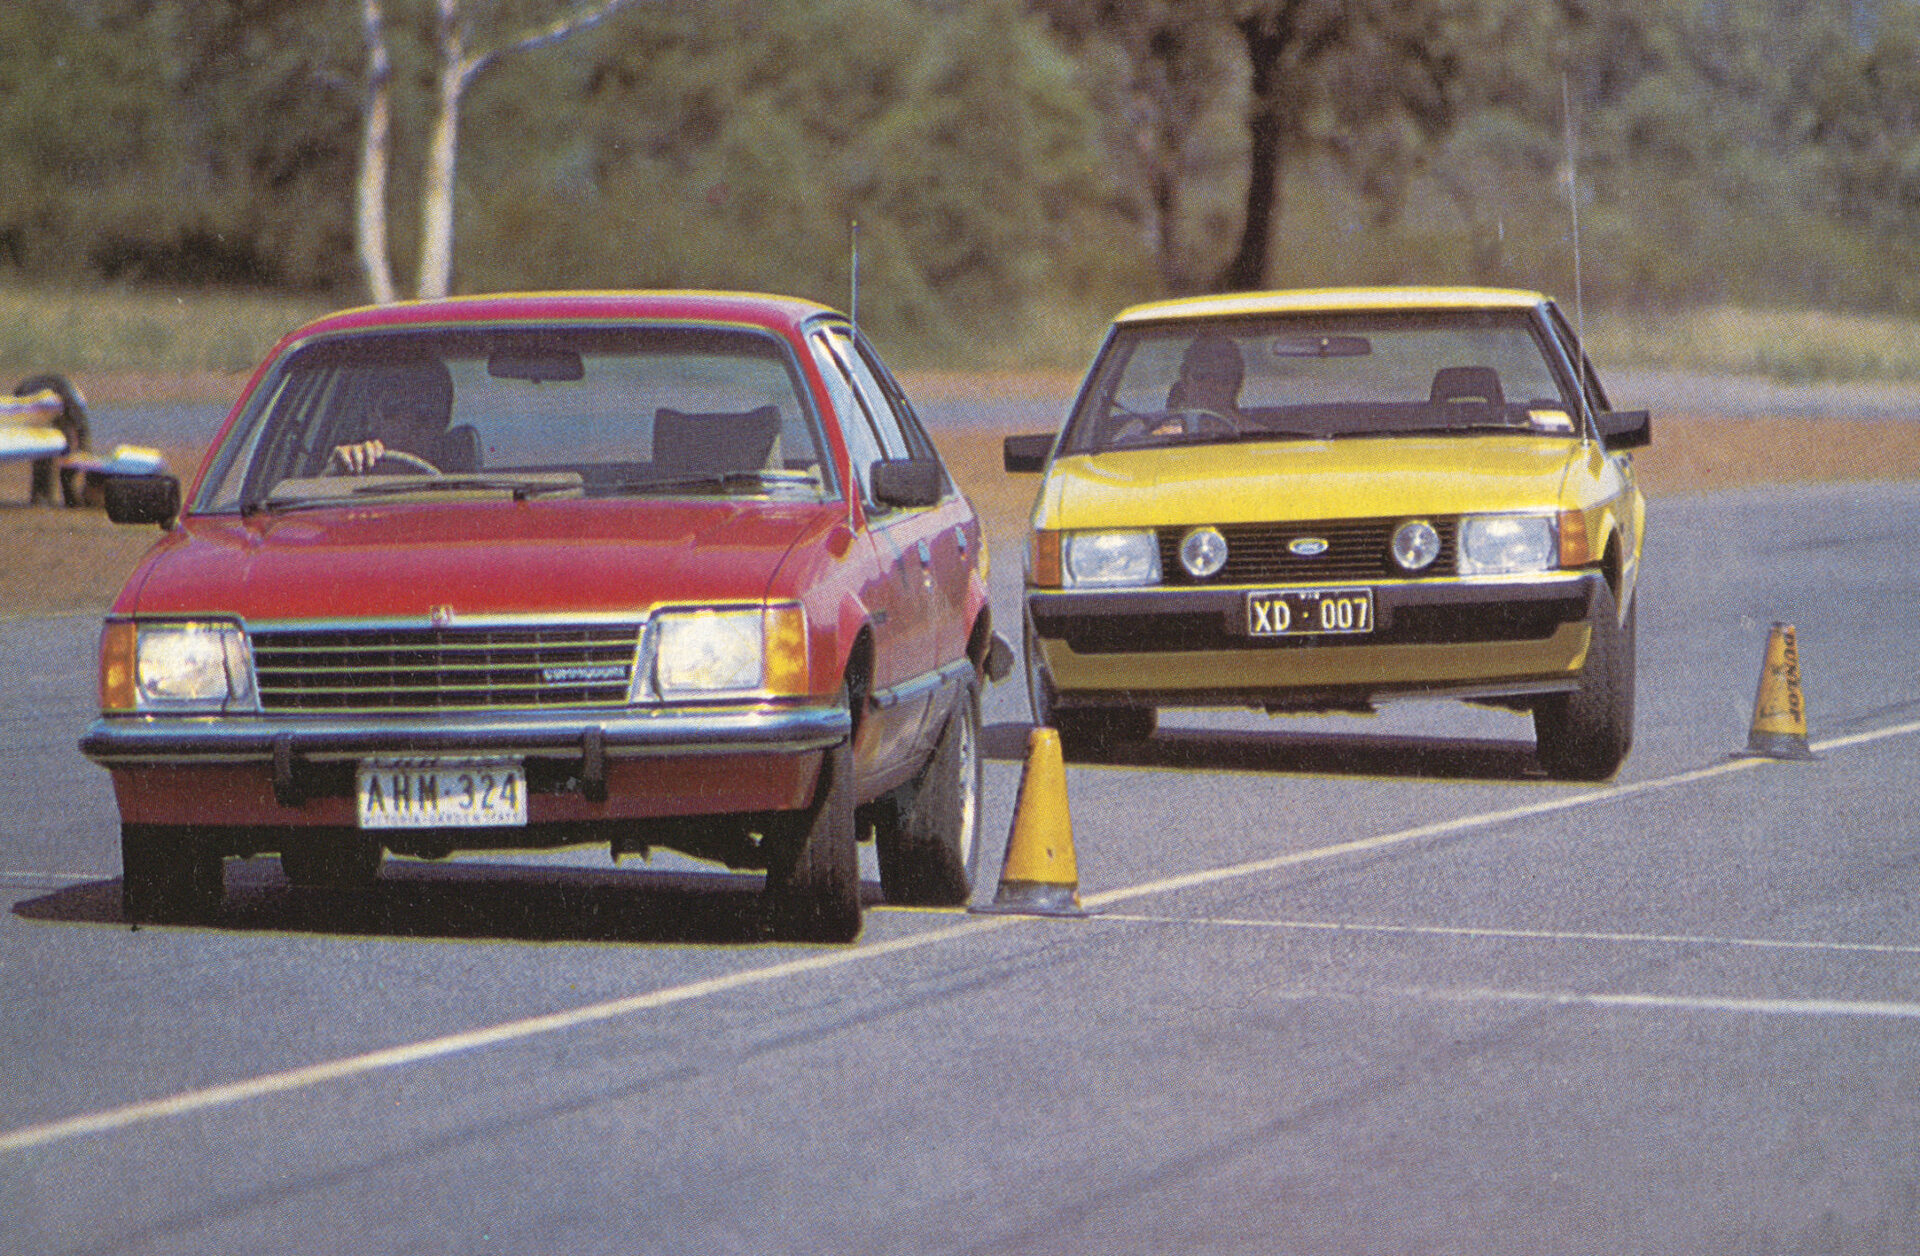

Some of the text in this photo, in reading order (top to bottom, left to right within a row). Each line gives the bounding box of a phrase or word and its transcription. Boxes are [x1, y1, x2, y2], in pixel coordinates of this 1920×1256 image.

[1254, 598, 1367, 632] XD 007
[1783, 632, 1800, 723] DUNLOP
